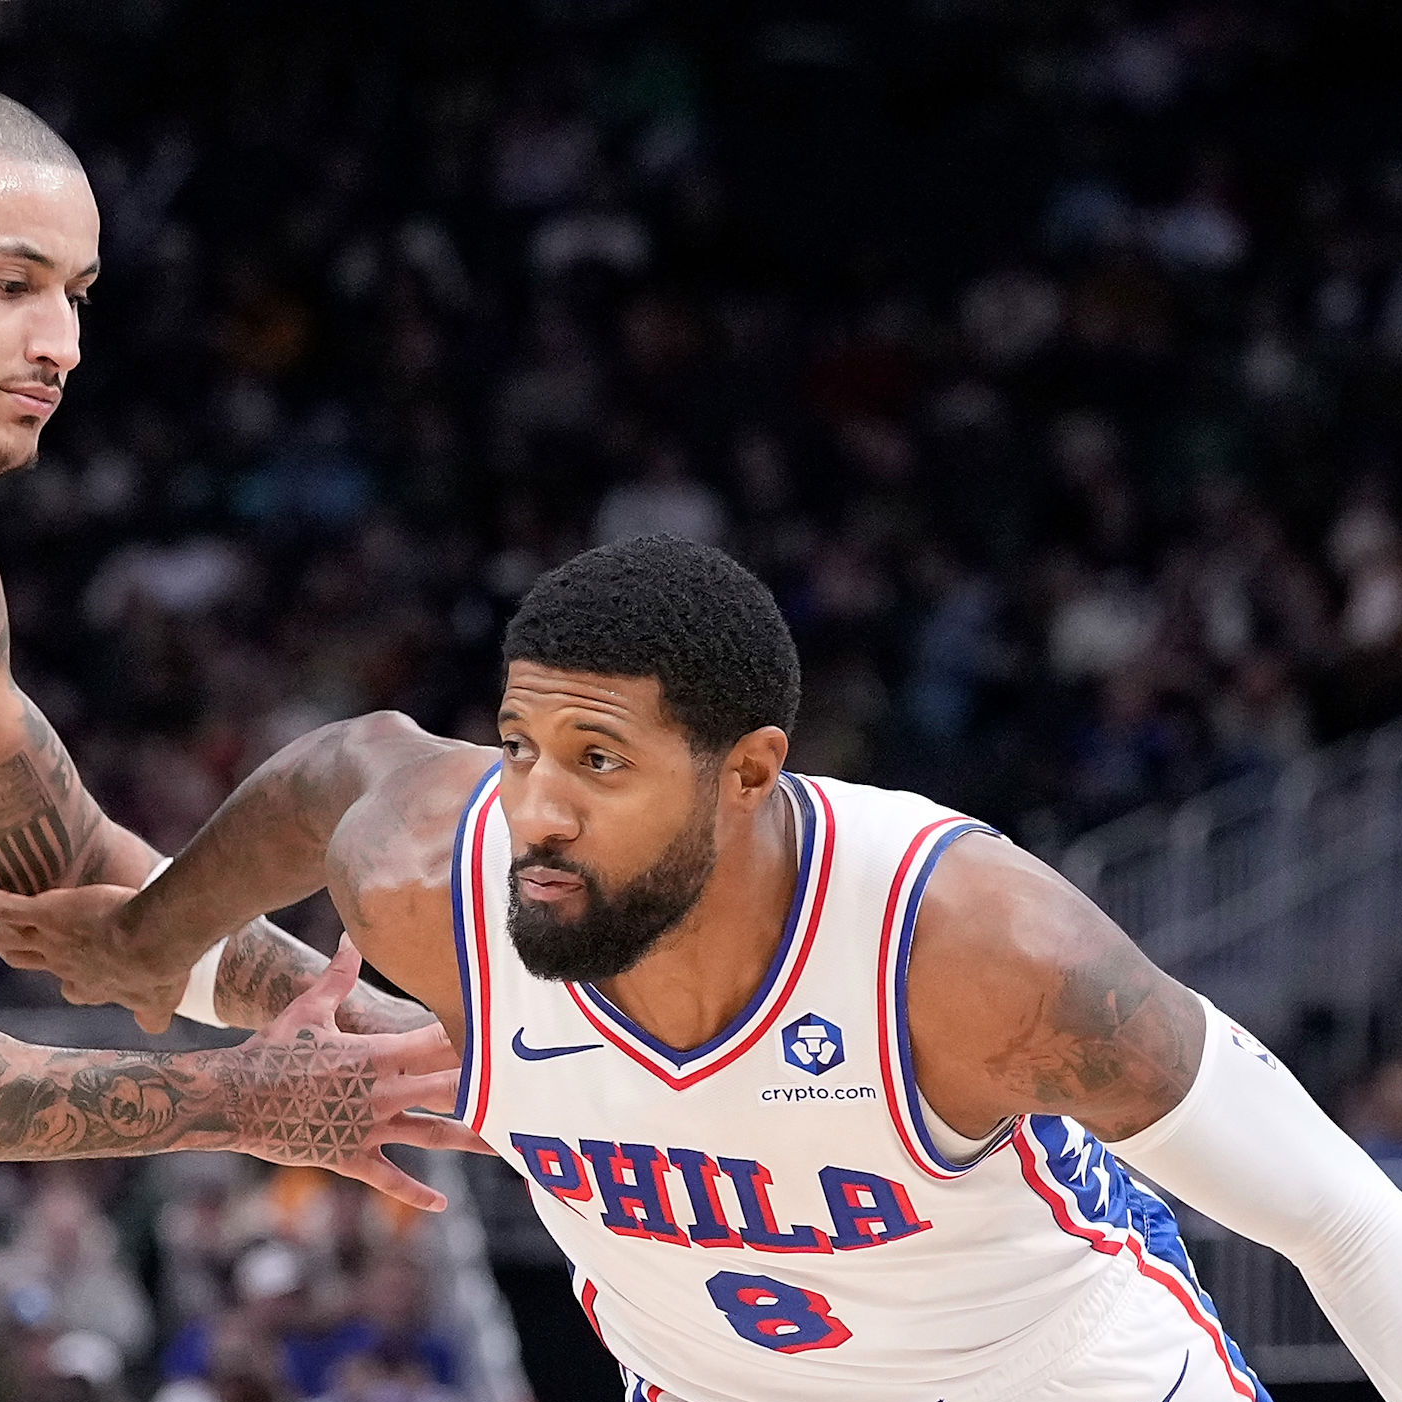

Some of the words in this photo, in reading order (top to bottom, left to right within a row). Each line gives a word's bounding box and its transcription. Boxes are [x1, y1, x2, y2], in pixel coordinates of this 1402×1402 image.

[761, 1085, 877, 1102] crypto.com
[509, 1132, 933, 1255] PHILA
[705, 1270, 854, 1355] 8
